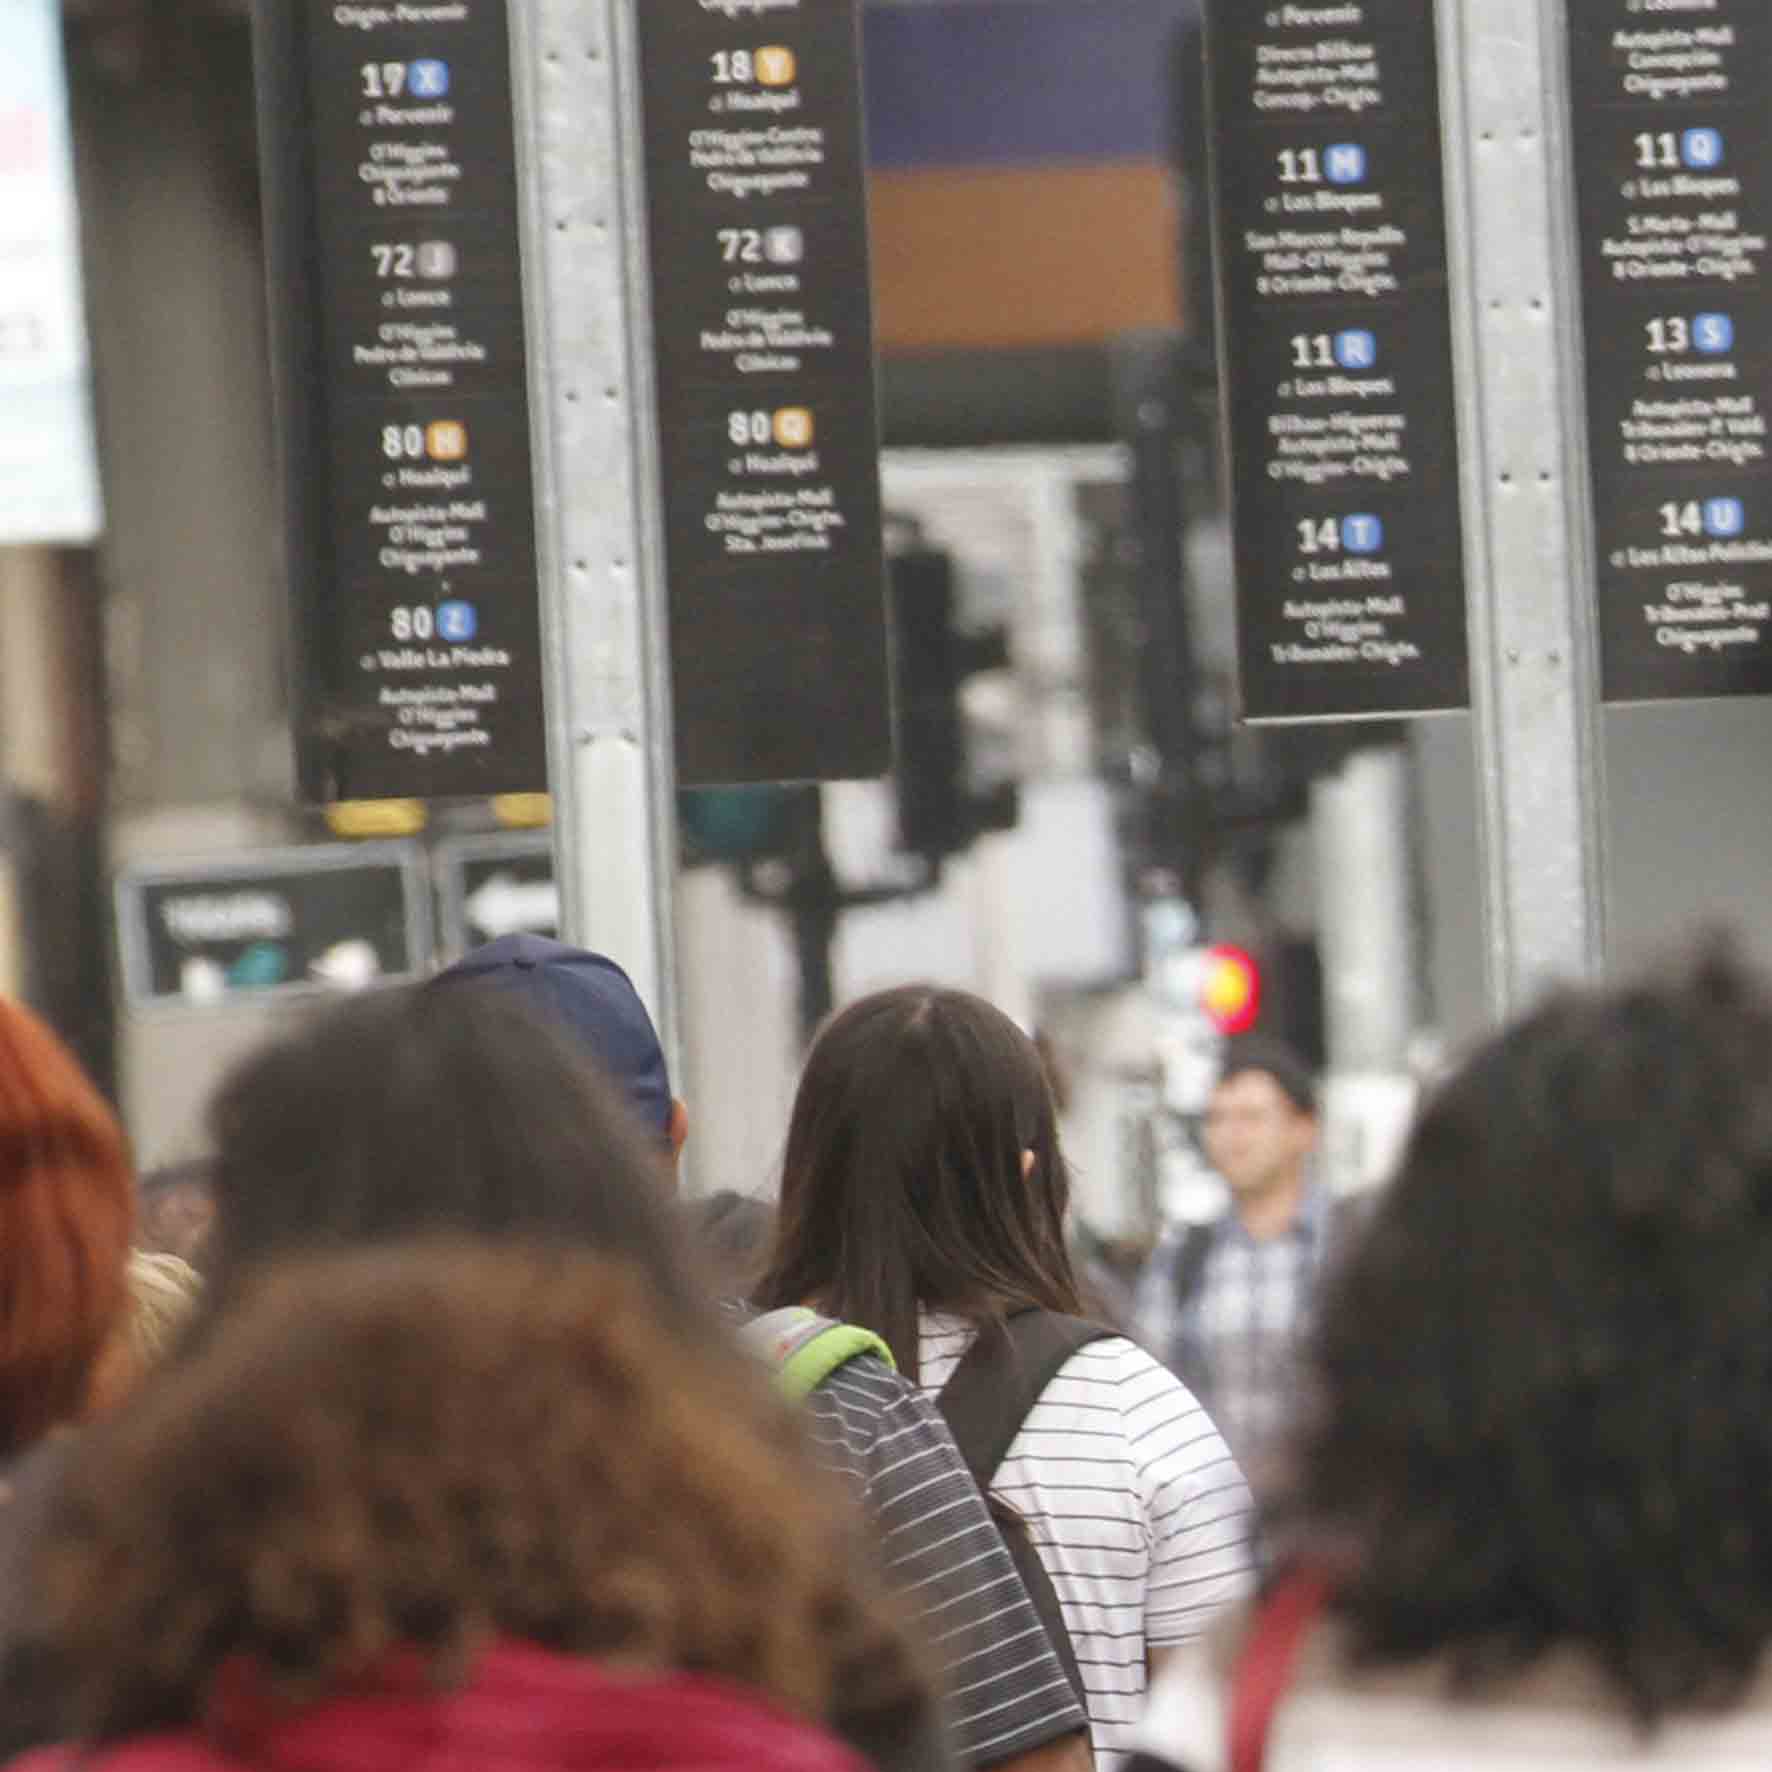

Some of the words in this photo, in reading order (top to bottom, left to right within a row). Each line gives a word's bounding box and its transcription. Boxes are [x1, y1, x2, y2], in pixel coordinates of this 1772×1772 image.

[362, 62, 406, 98] 17
[710, 50, 752, 83] 18
[1277, 149, 1322, 183] 11
[1634, 132, 1680, 168] 11
[371, 243, 414, 277] 72
[716, 229, 762, 262] 72
[1291, 333, 1335, 367] 11
[1645, 317, 1689, 353] 13
[382, 424, 422, 459] 80
[728, 411, 771, 446] 80
[1297, 517, 1340, 553] 14
[1660, 501, 1701, 536] 14
[392, 605, 433, 640] 80
